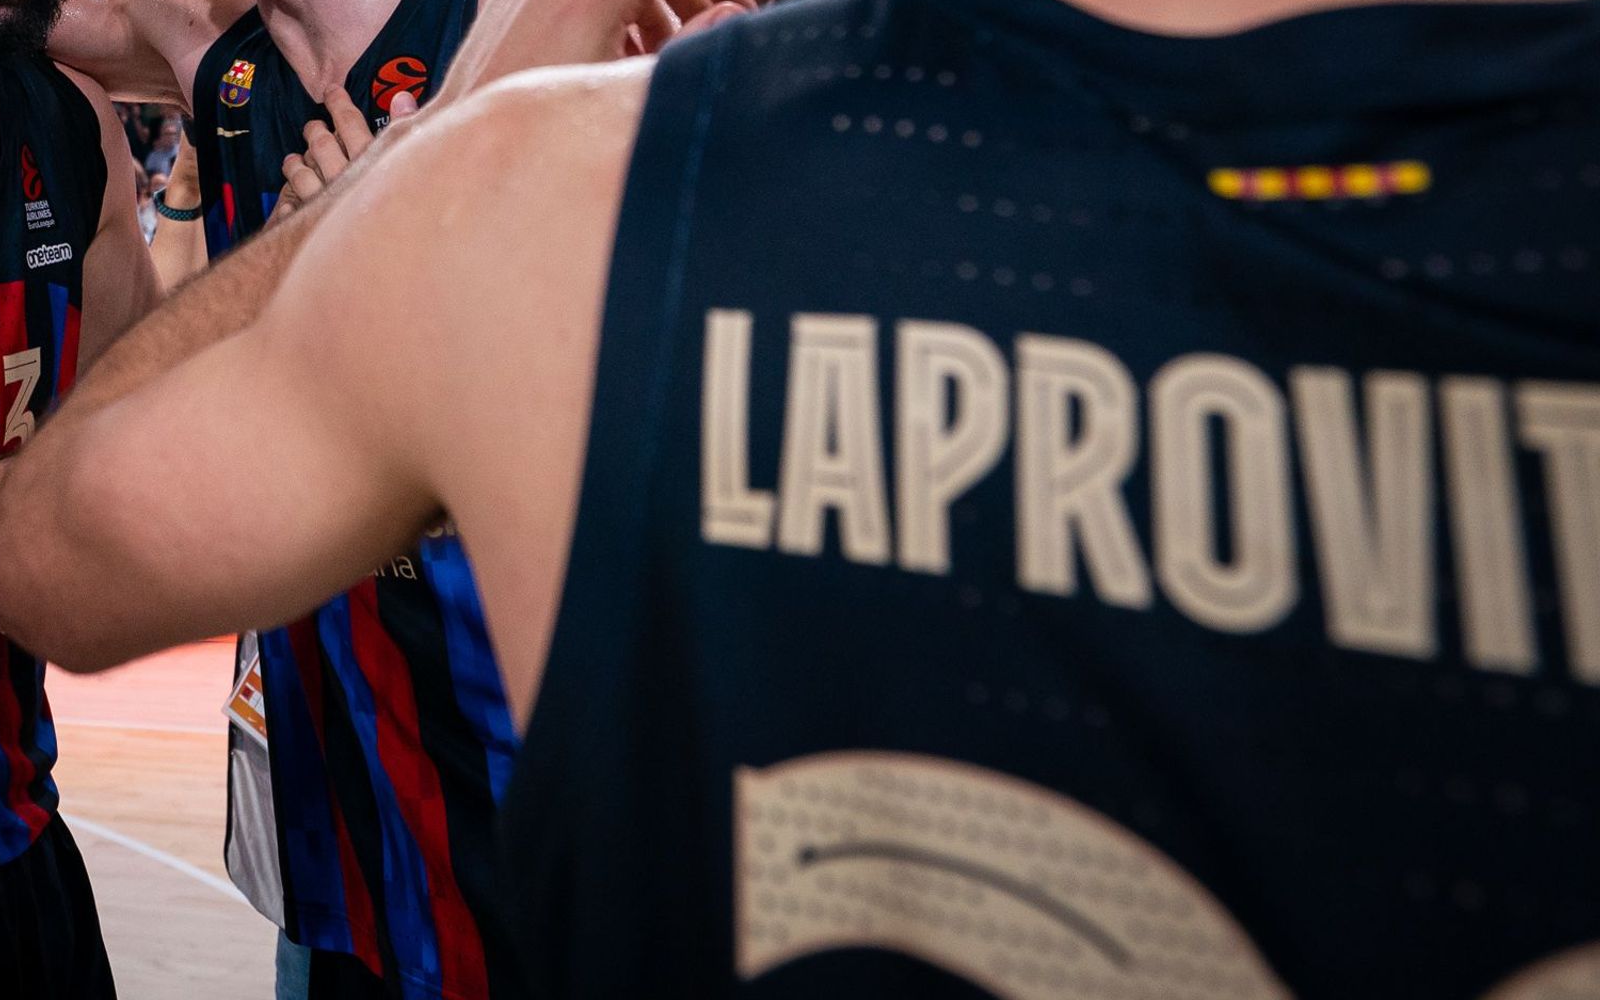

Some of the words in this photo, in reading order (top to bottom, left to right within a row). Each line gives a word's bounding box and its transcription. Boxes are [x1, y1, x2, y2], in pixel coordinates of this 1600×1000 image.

[25, 200, 49, 211] TURKISH
[26, 209, 52, 221] AIRLINES
[26, 243, 72, 269] oneteam
[699, 307, 1600, 688] LAPROVIT
